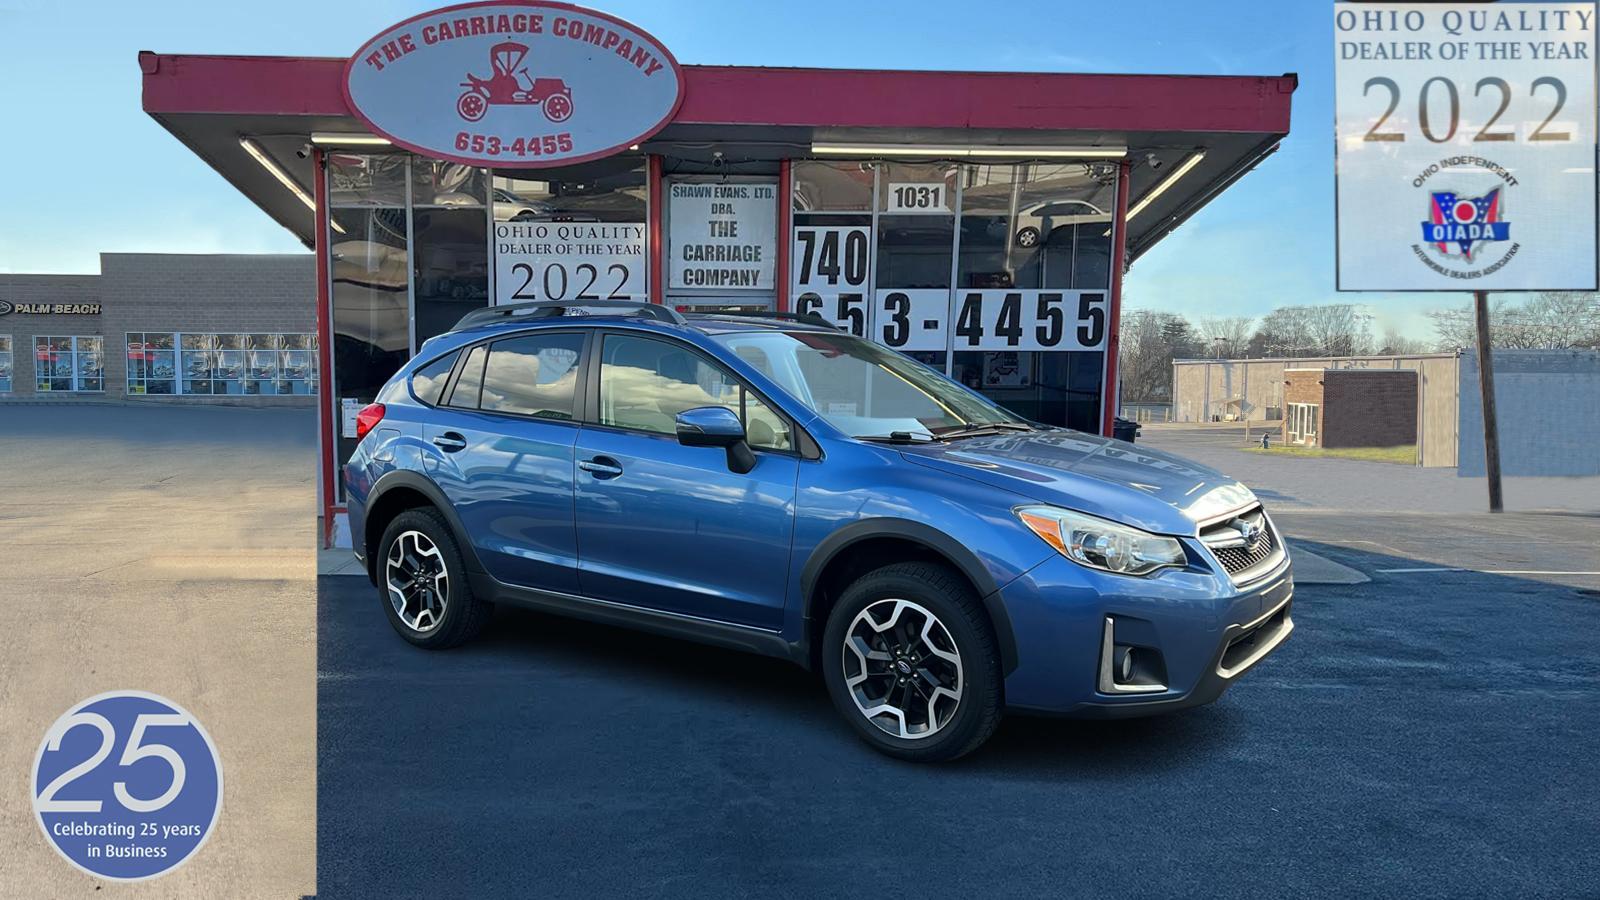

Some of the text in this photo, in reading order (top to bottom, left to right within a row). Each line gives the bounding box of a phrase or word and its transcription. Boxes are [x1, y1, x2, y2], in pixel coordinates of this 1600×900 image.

[1336, 10, 1593, 35] OHIO QUALITY
[365, 15, 664, 77] THE CARRIAGE COMPANY
[1340, 42, 1589, 60] DEALER OF THE YEAR
[1362, 76, 1571, 143] 2022
[454, 132, 574, 156] 653-4455
[1412, 156, 1519, 188] OHIO INDEPENDENT
[672, 186, 712, 198] SHAWN
[754, 188, 774, 199] LTD.
[894, 186, 940, 208] 1031
[711, 203, 736, 215] DBA.
[497, 226, 644, 241] OHIO QUALITY
[708, 220, 738, 238] THE
[1432, 224, 1495, 241] OIADA
[499, 244, 641, 255] DEALER OF THE YEAR
[683, 244, 762, 262] CARRIAGE
[797, 229, 868, 287] 740
[1411, 242, 1520, 279] AUTOMOBILE DEALERS ASSOCIATION
[511, 263, 632, 301] 2022
[683, 268, 760, 286] COMPANY
[15, 303, 100, 314] PALM BEACH
